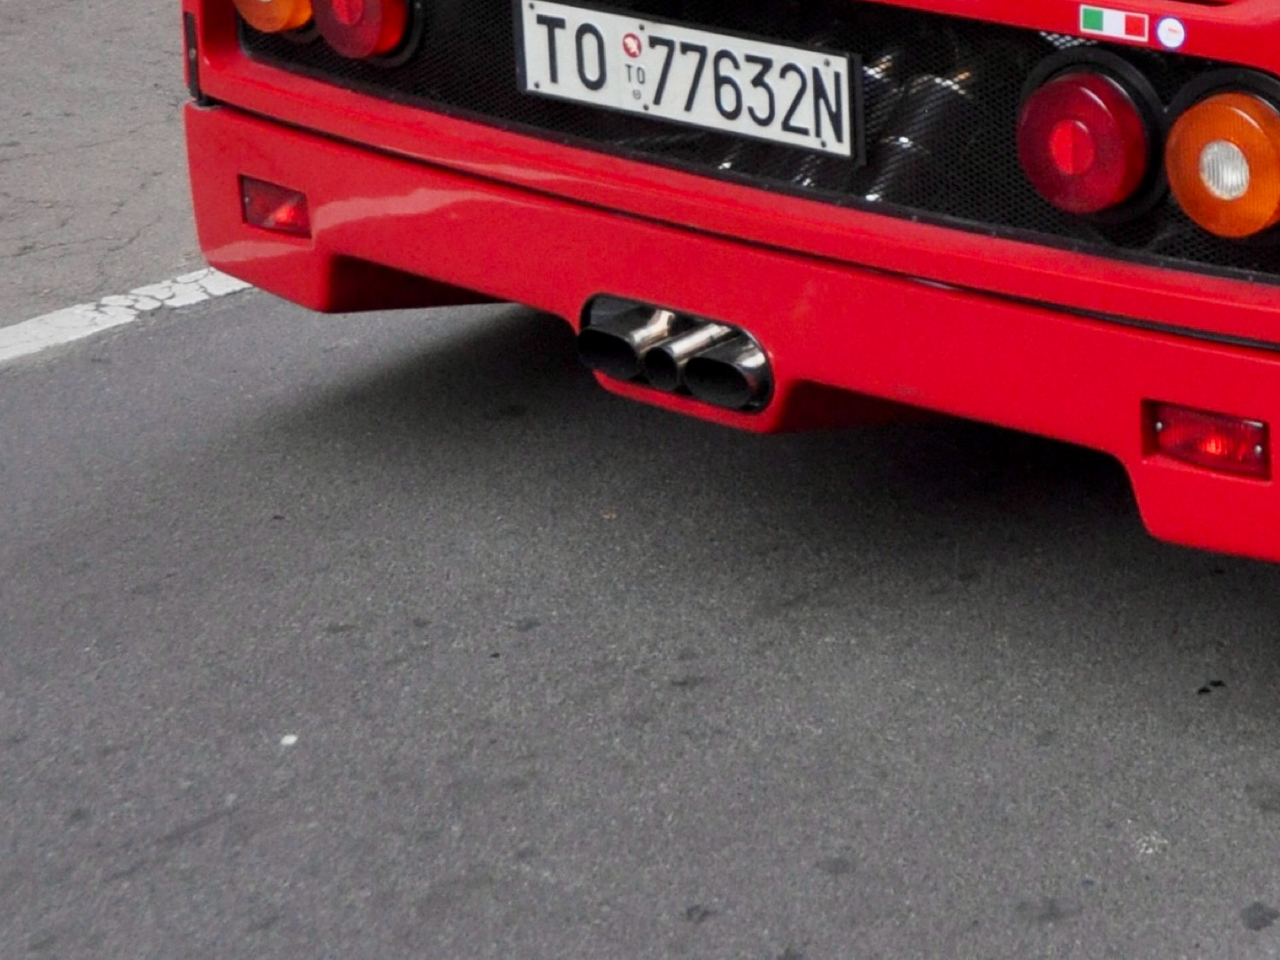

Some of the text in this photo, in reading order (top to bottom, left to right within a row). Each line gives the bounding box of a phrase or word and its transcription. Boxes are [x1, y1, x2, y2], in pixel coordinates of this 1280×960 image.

[536, 14, 844, 144] TO 77632N
[625, 63, 646, 85] TO
